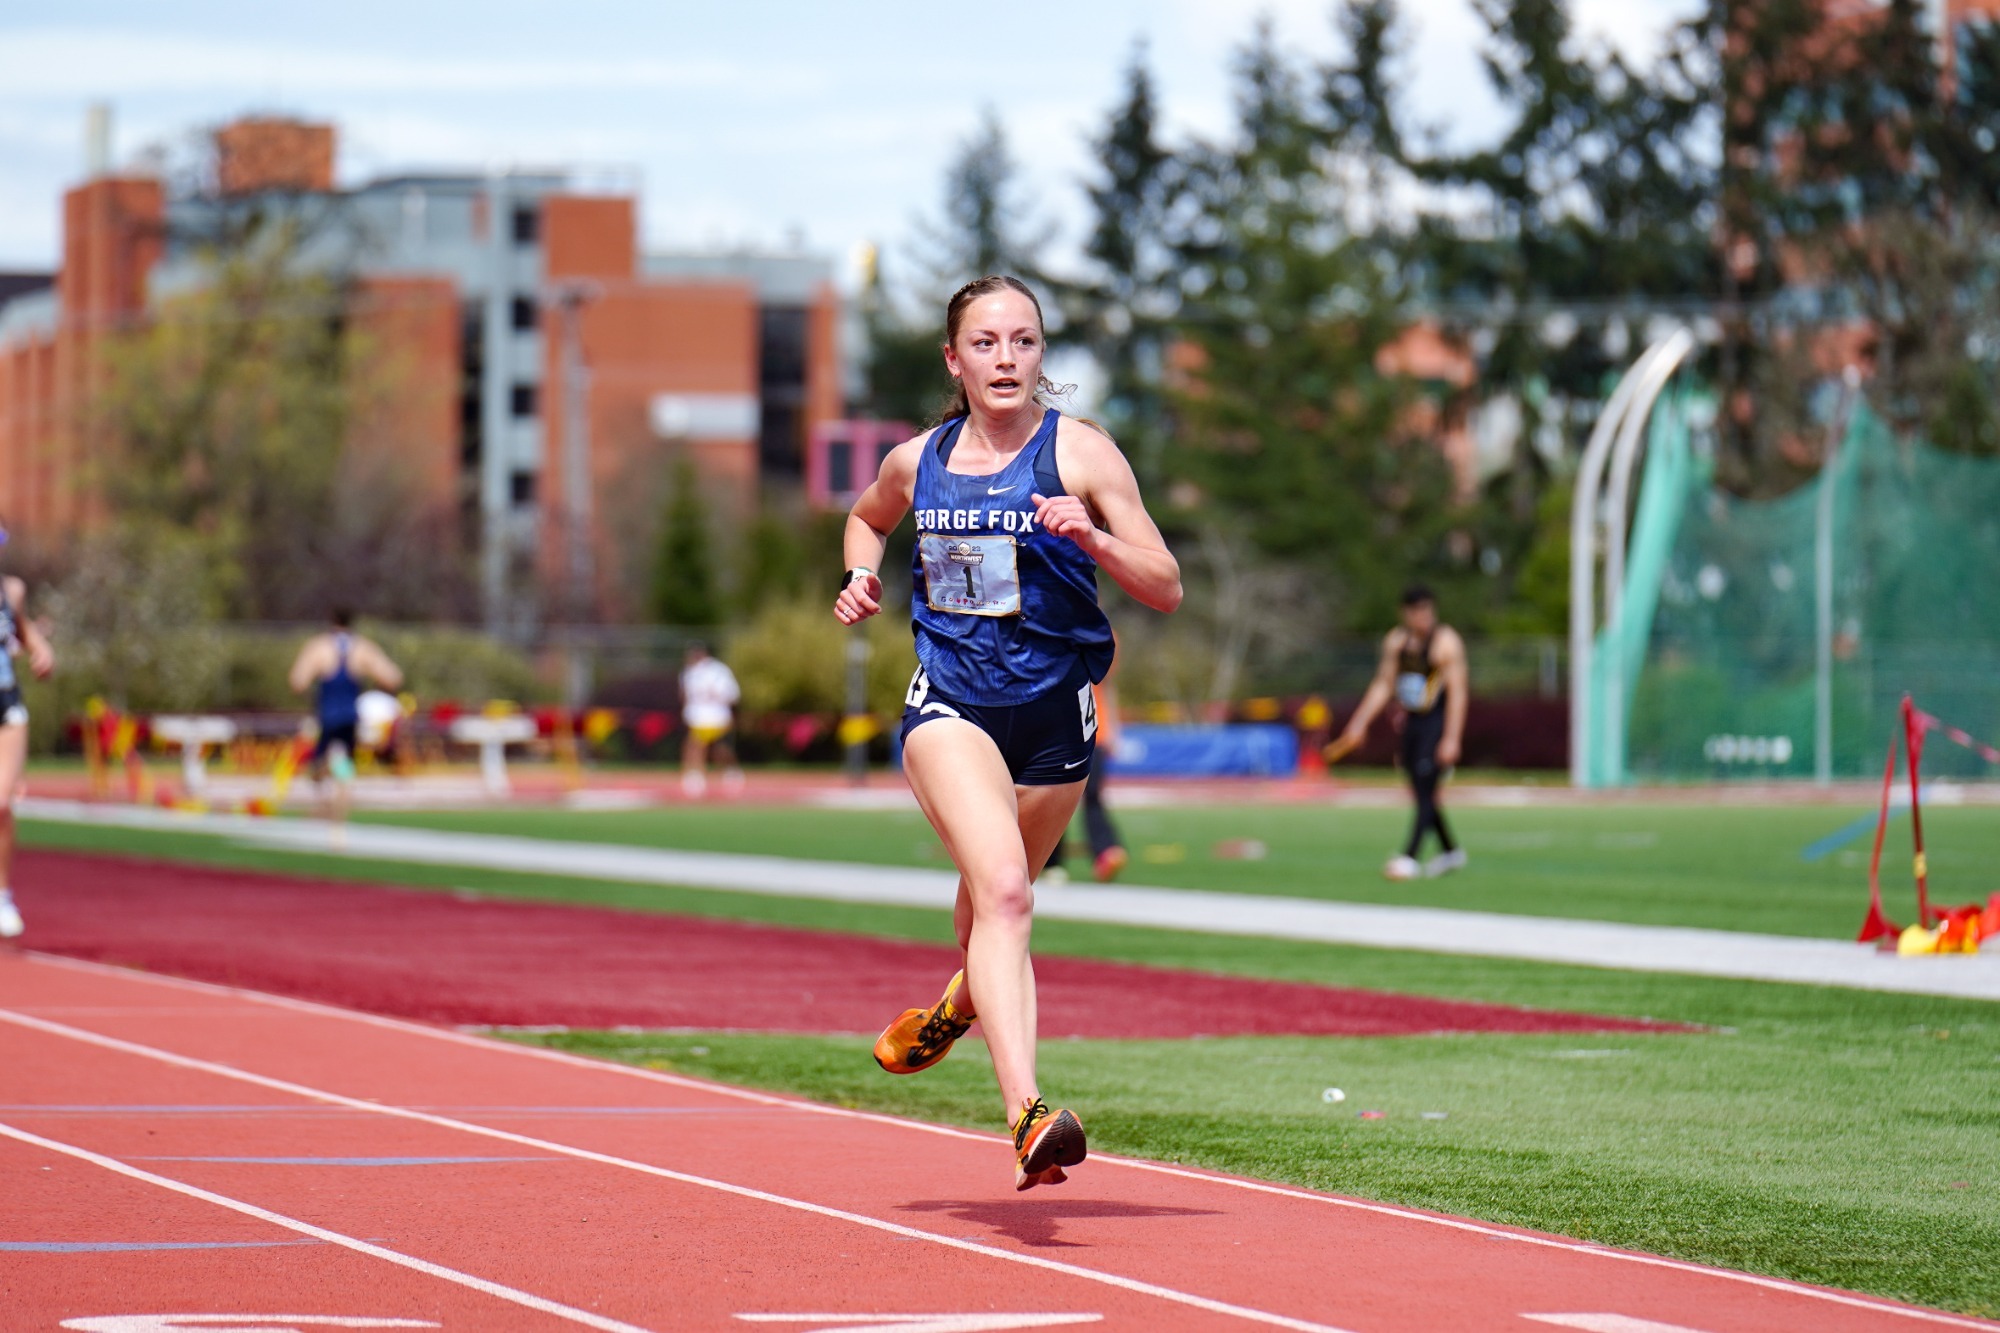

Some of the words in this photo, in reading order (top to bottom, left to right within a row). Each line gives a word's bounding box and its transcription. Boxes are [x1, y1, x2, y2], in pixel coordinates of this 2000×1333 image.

[989, 510, 1035, 532] FOX
[963, 566, 976, 598] 1
[1084, 681, 1096, 728] 4
